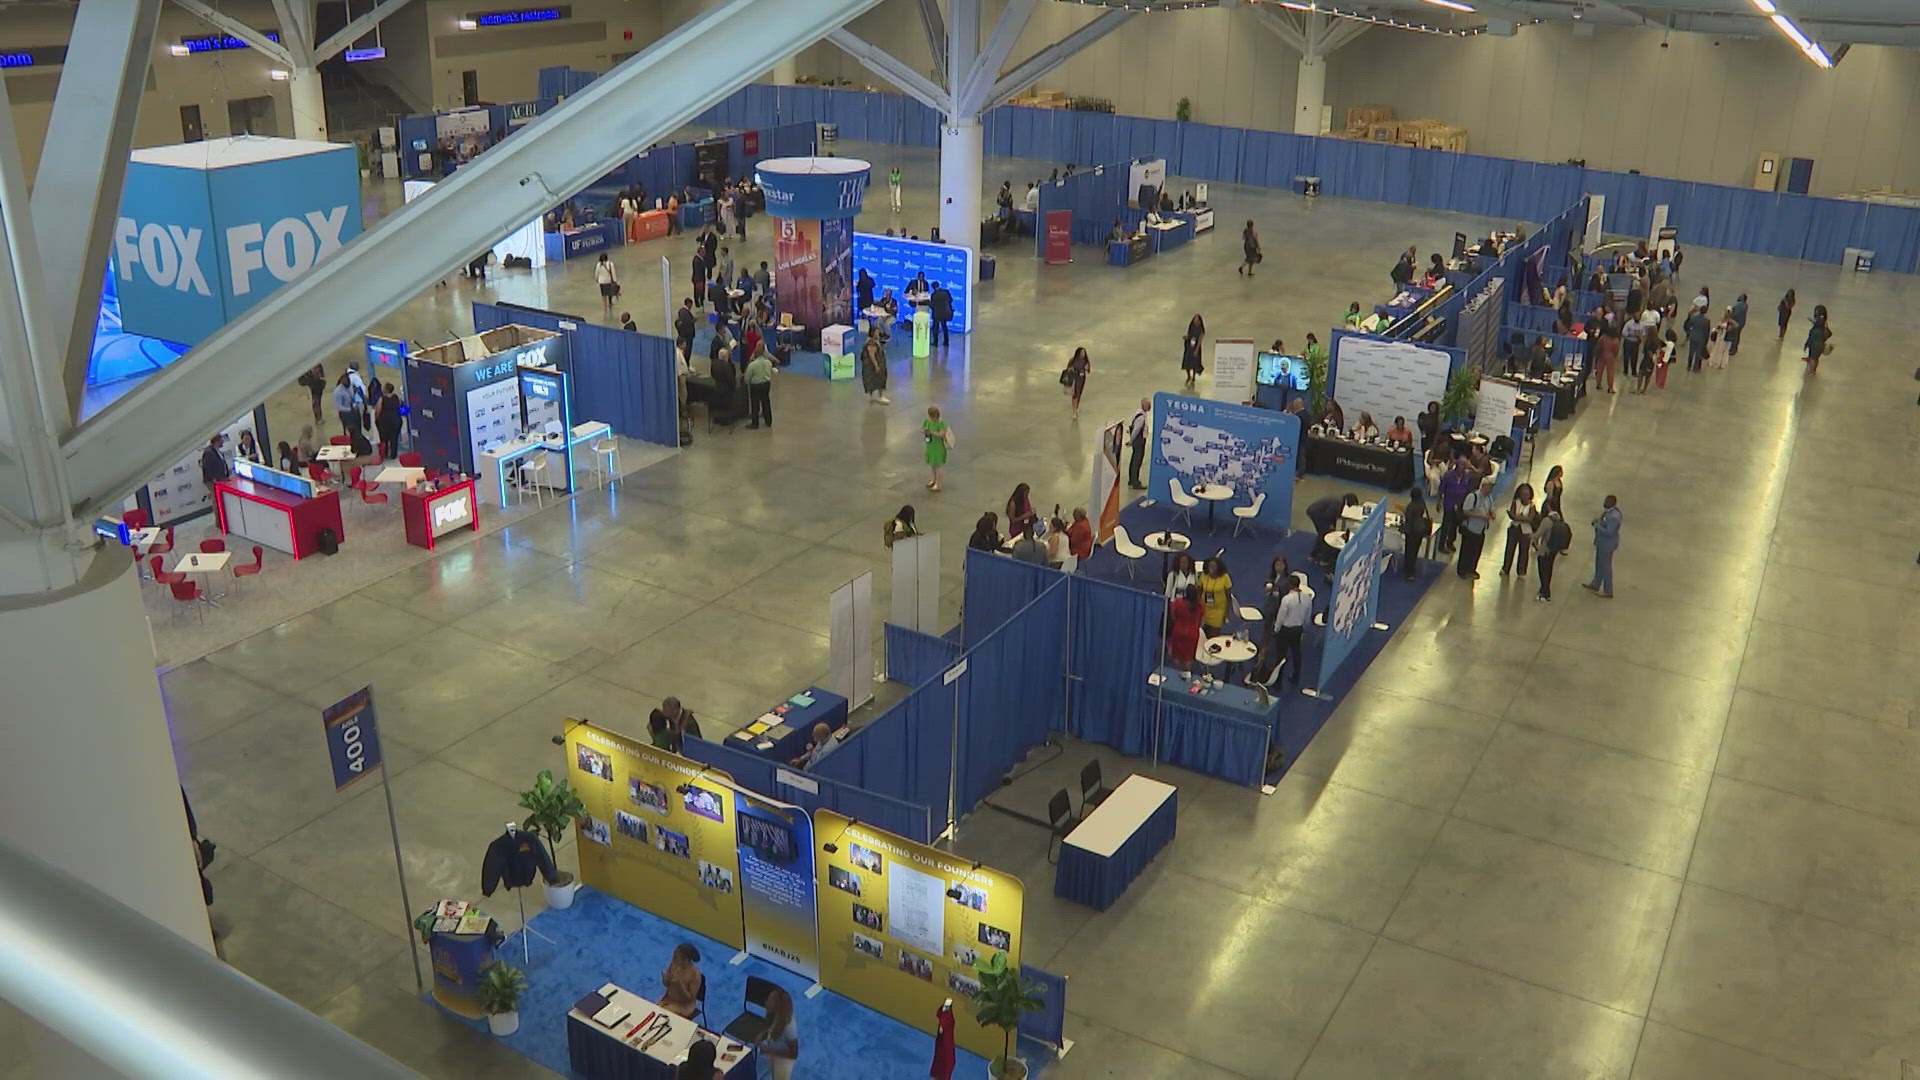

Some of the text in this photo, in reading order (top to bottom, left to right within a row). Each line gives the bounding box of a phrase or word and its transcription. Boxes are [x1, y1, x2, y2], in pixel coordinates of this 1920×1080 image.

[115, 217, 212, 297] FOX
[226, 205, 349, 297] FOX
[475, 346, 547, 382] WE ARE FOX
[434, 497, 468, 528] FOX
[343, 725, 365, 773] 400
[585, 731, 641, 759] CELEBRATING
[641, 752, 664, 766] OUR
[844, 827, 994, 888] CELEBRATING OUR FOUNDERS
